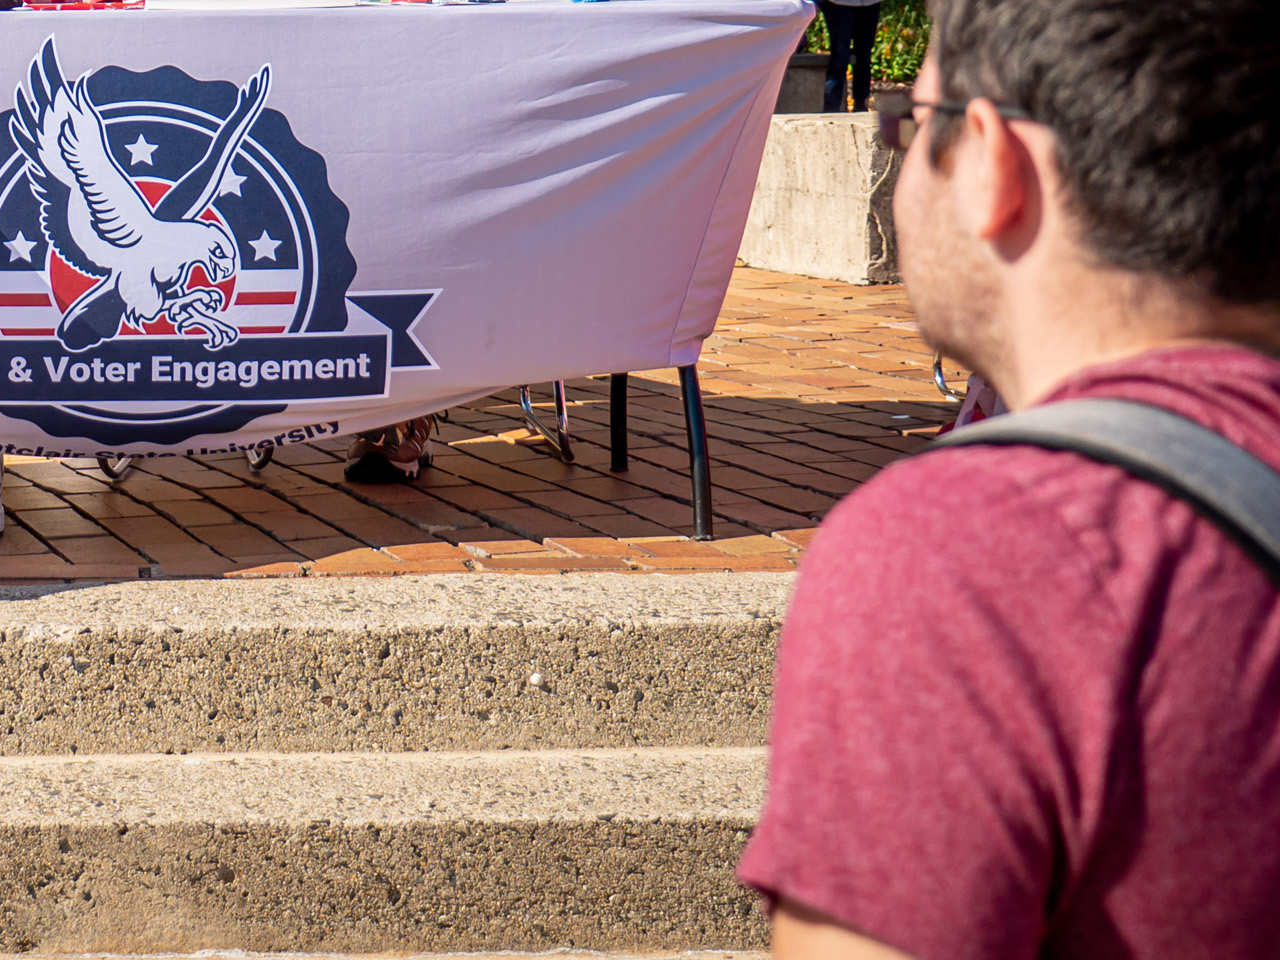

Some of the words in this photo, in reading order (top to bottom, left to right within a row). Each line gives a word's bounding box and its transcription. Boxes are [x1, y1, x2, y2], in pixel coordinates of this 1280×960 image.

[7, 355, 33, 383] &
[43, 356, 141, 383] Voter
[151, 353, 370, 388] Engagement
